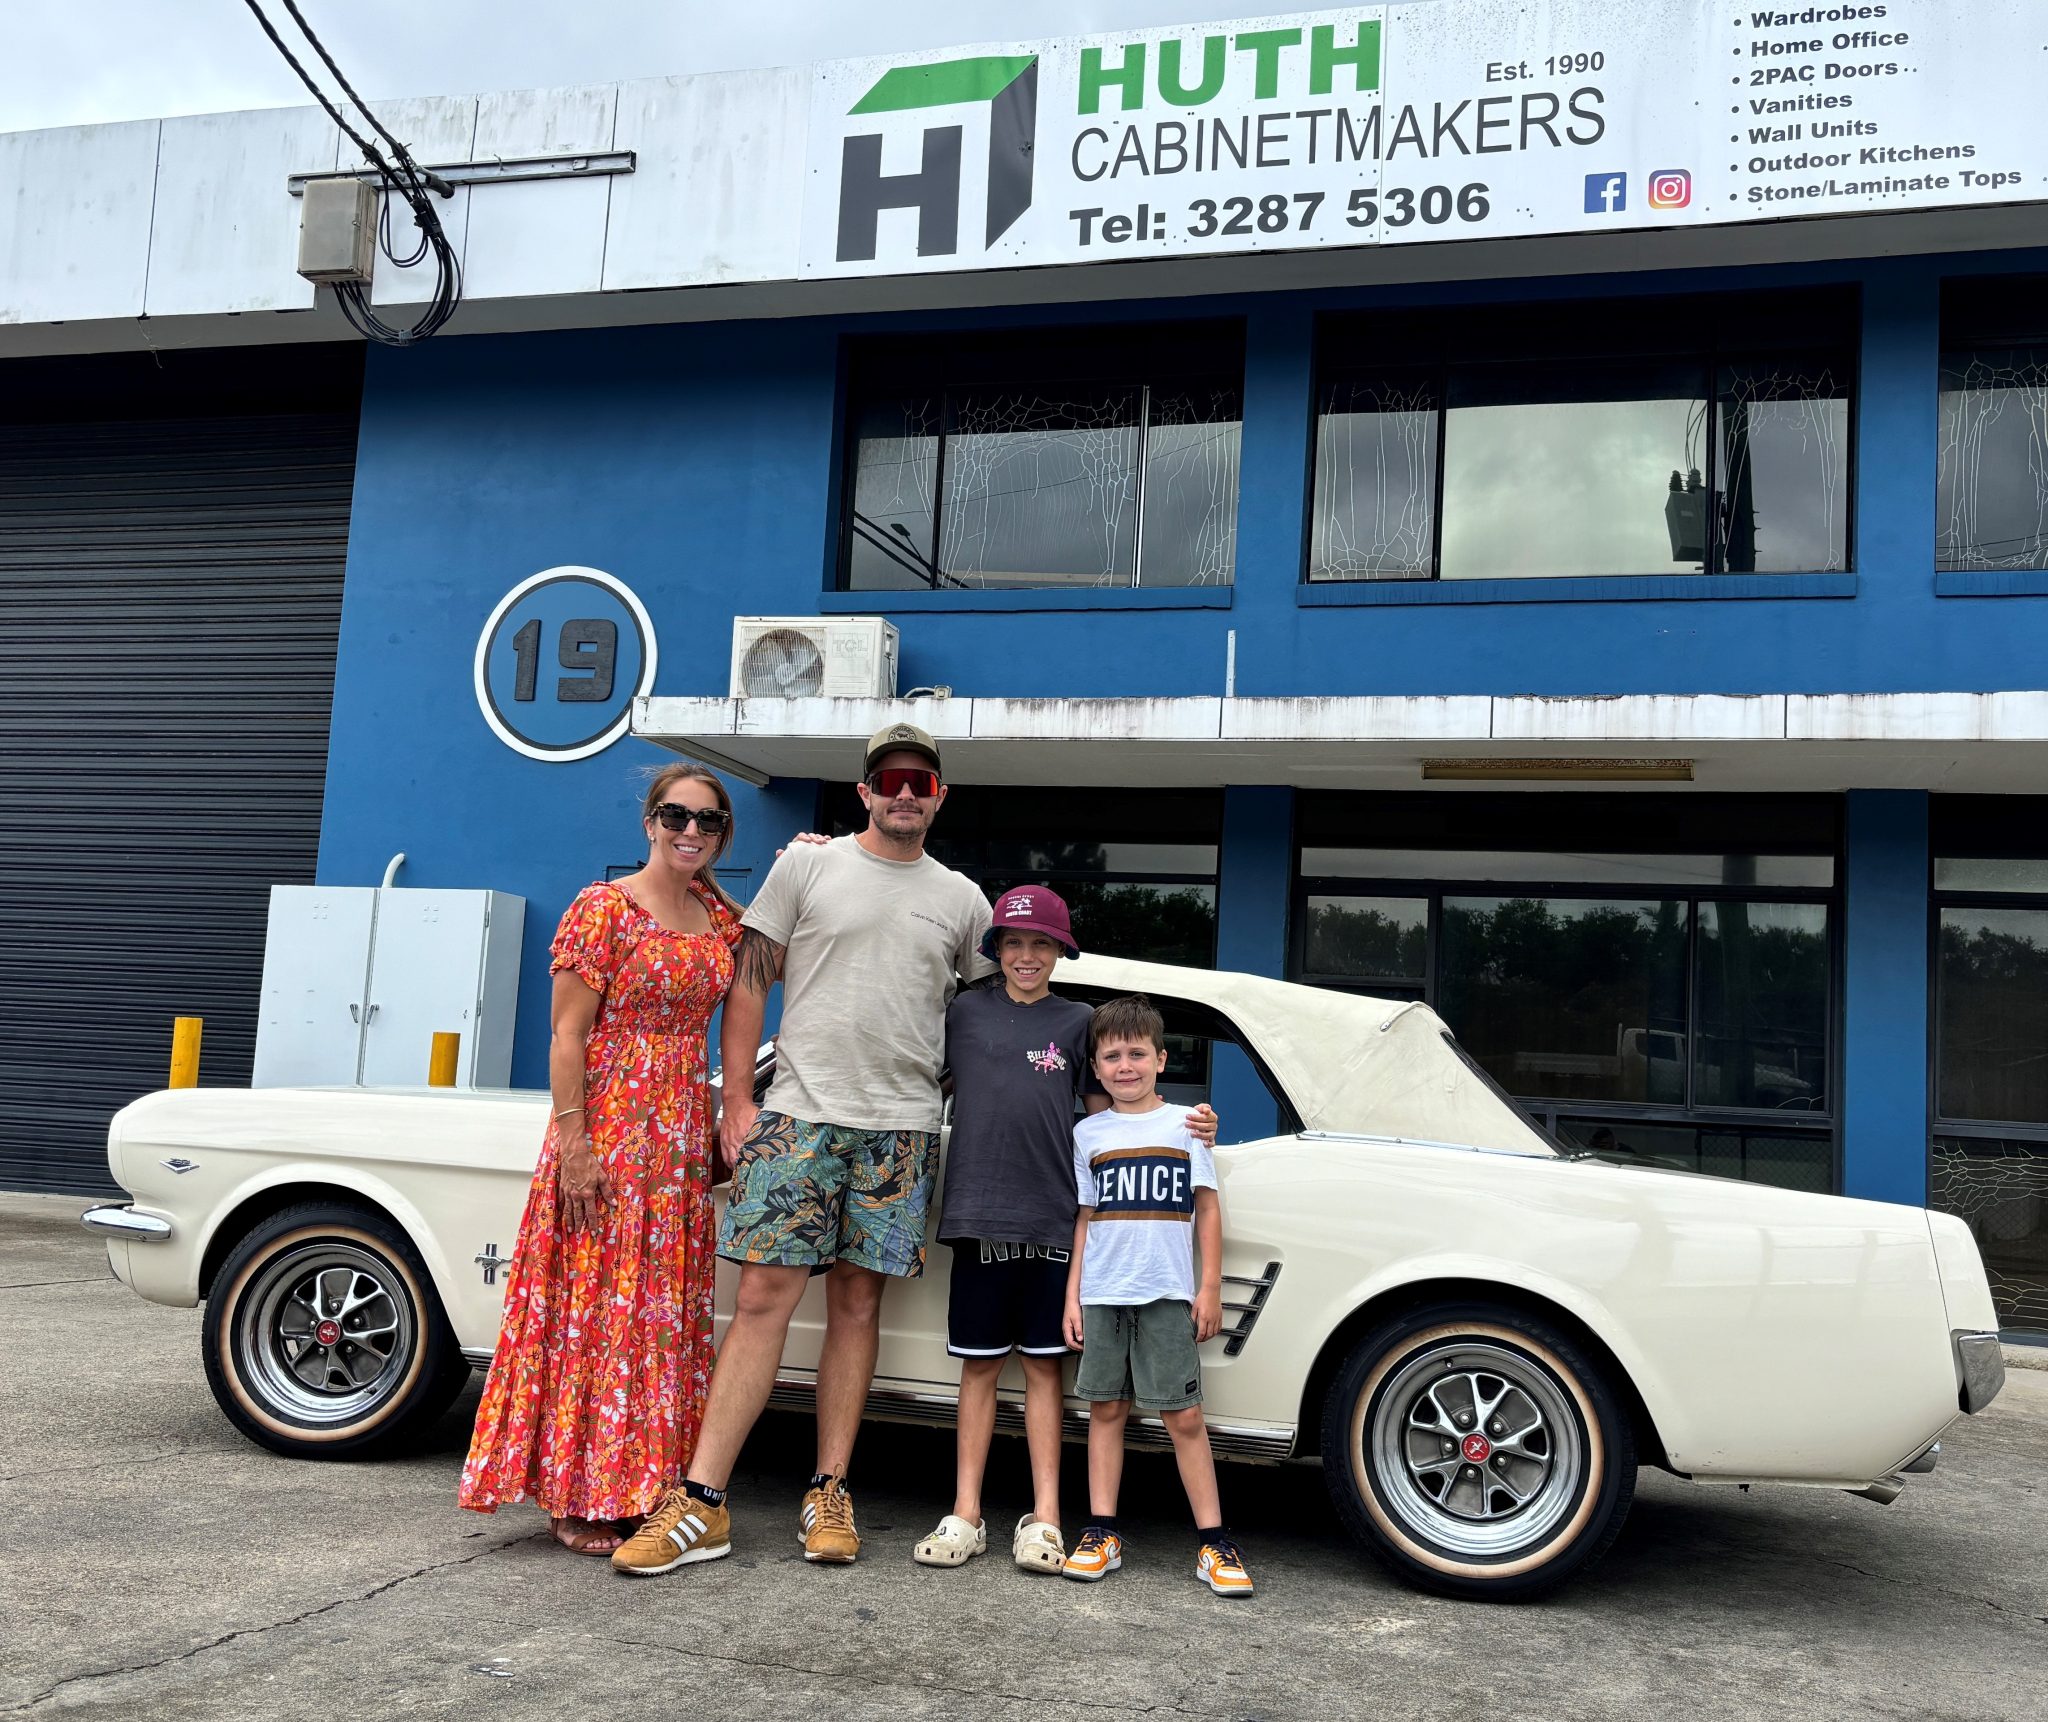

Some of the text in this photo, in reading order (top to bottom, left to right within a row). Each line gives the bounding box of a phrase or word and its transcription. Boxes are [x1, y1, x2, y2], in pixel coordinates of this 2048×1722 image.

[1751, 5, 1887, 28] Wardrobes
[1751, 30, 1909, 57] Home Office
[1077, 19, 1382, 115] HUTH
[1486, 51, 1605, 82] Est. 1990
[1749, 62, 1899, 87] 2PAC Doors
[1749, 93, 1853, 115] Vanities
[1071, 86, 1606, 182] CABINETMAKERS
[1748, 119, 1878, 145] Wall Units
[1748, 144, 1976, 174] Outdoor Kitchens
[1747, 170, 2022, 203] Stone/Laminate Tops
[1068, 182, 1490, 246] Tel: 3287 5306
[512, 618, 618, 702] 19
[832, 639, 869, 651] TCL
